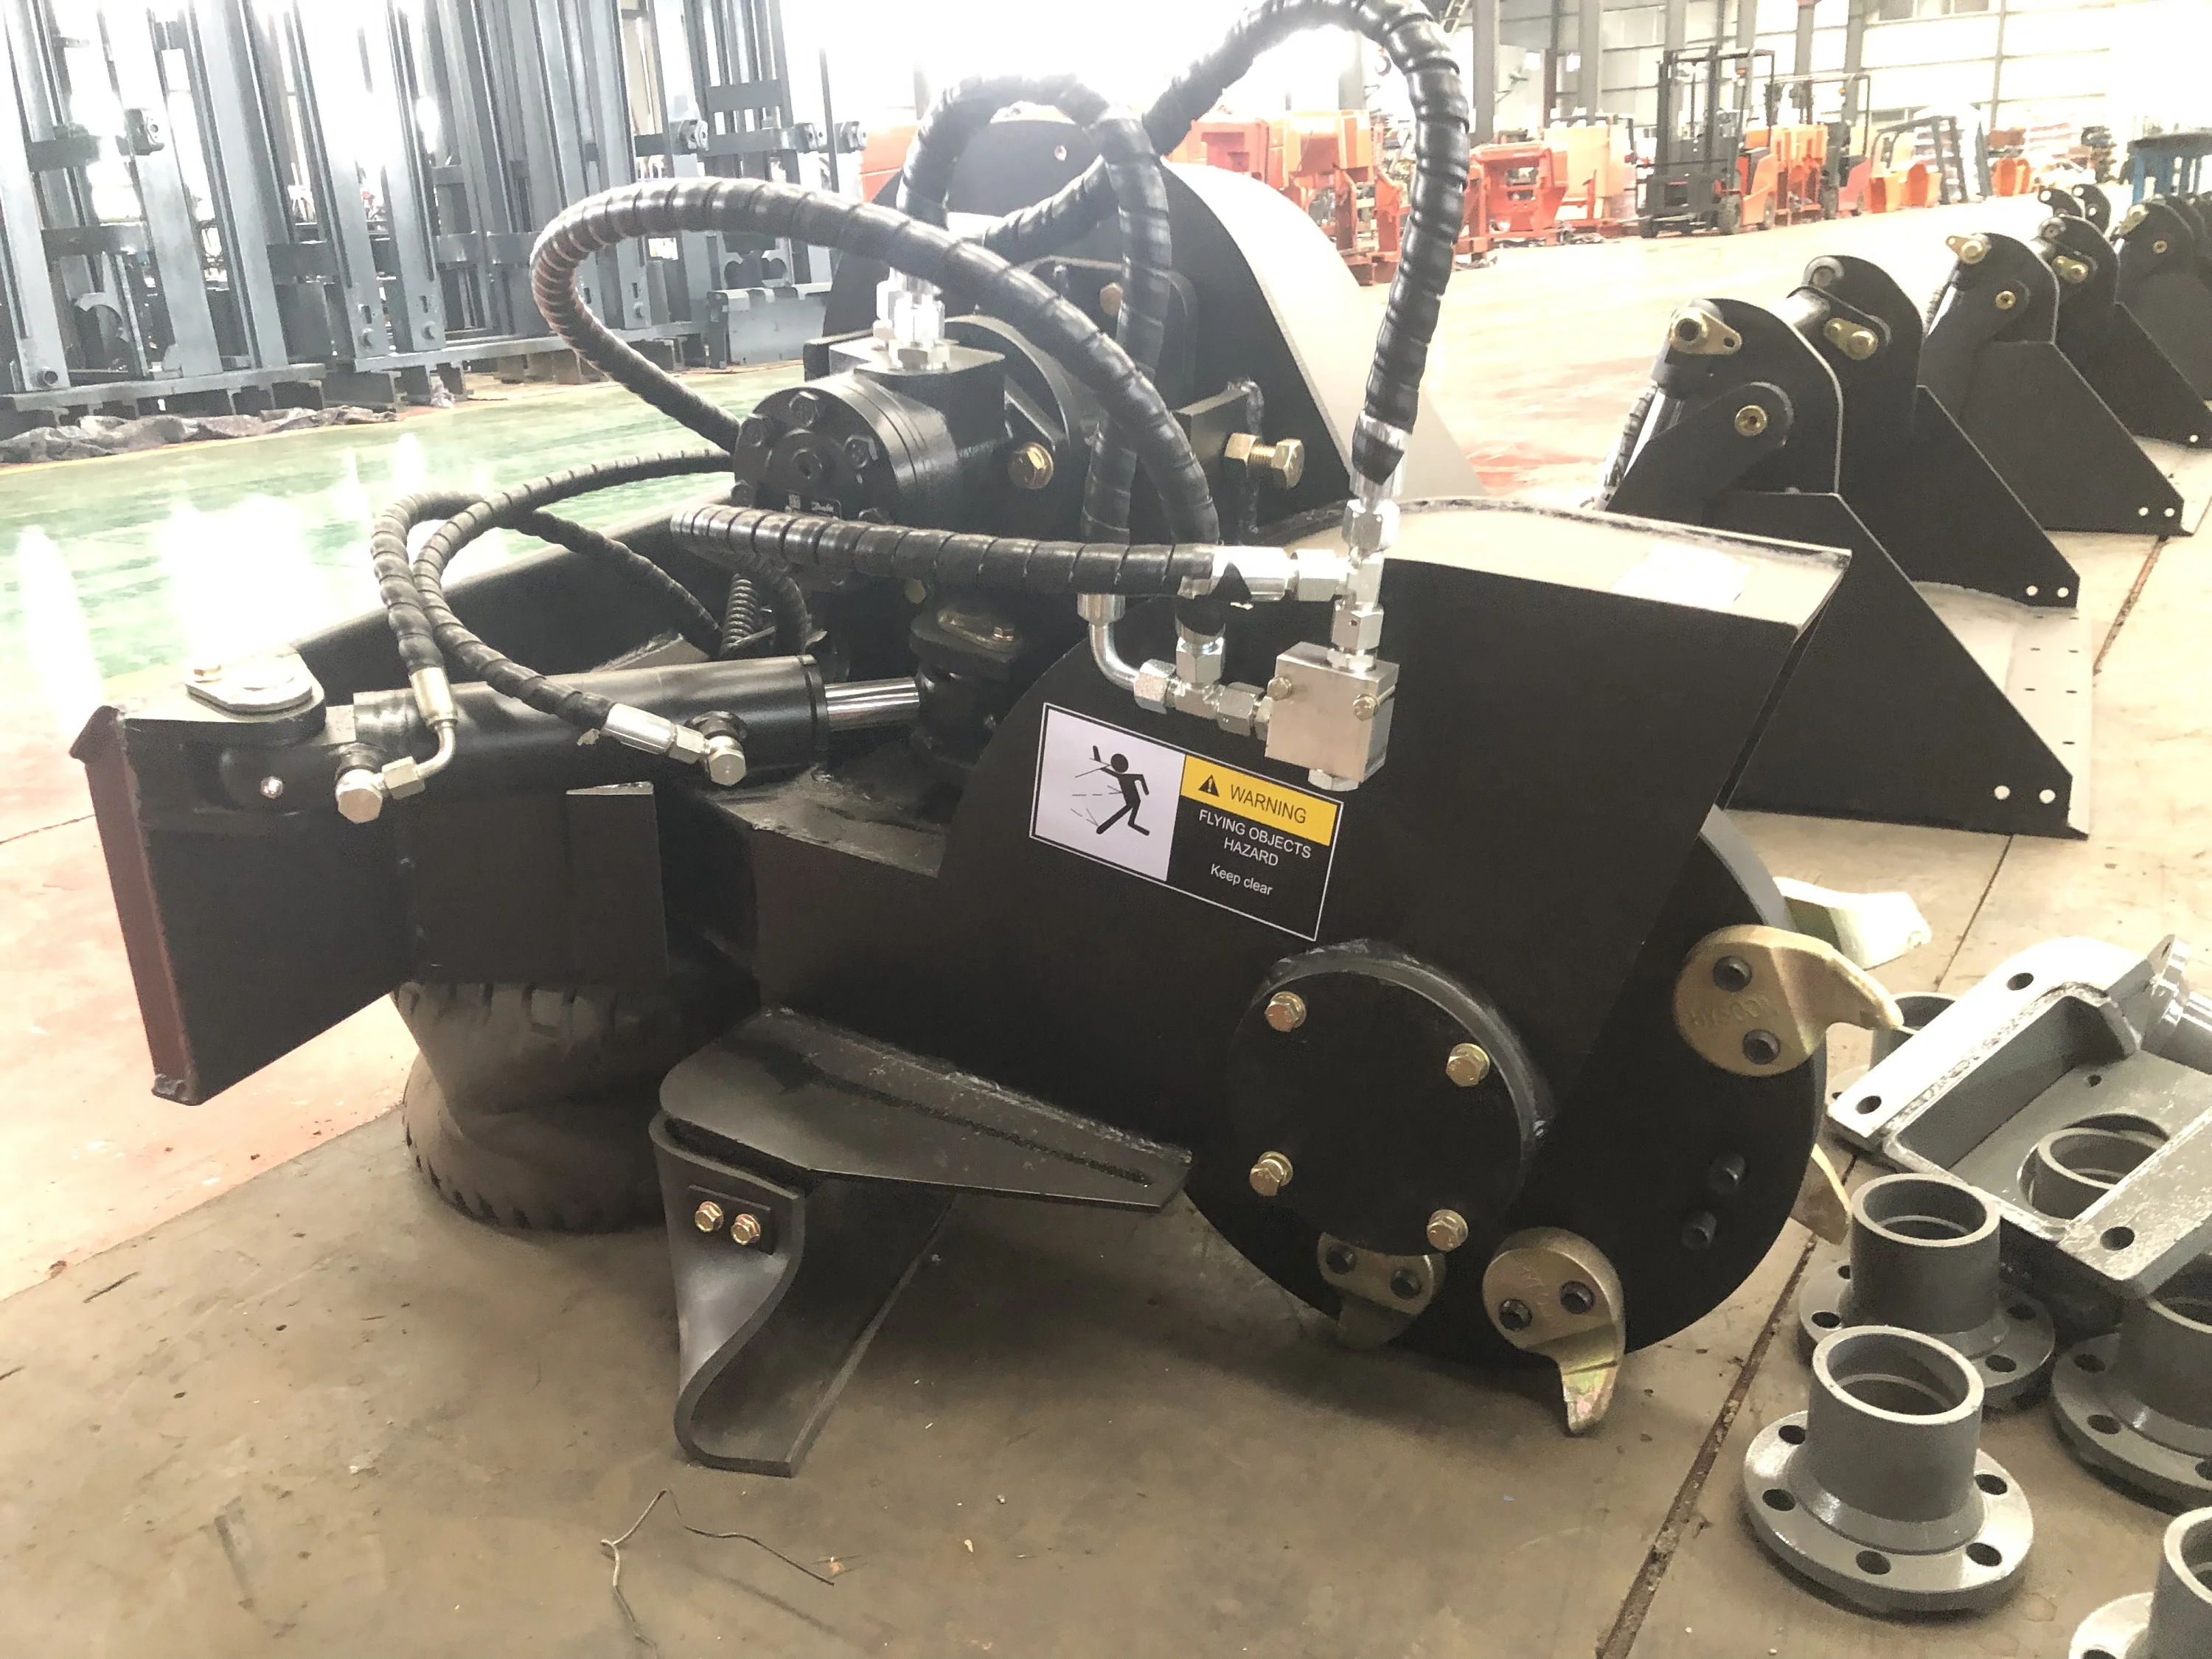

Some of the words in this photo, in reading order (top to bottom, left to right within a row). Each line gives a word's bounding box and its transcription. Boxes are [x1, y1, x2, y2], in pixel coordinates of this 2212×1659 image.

[1230, 784, 1307, 824] WARNING
[1198, 810, 1245, 836] FLYING
[1248, 827, 1312, 859] OBJECTS
[1224, 838, 1279, 866] HAZARD
[1210, 863, 1242, 886] Keep
[1243, 876, 1273, 896] clear
